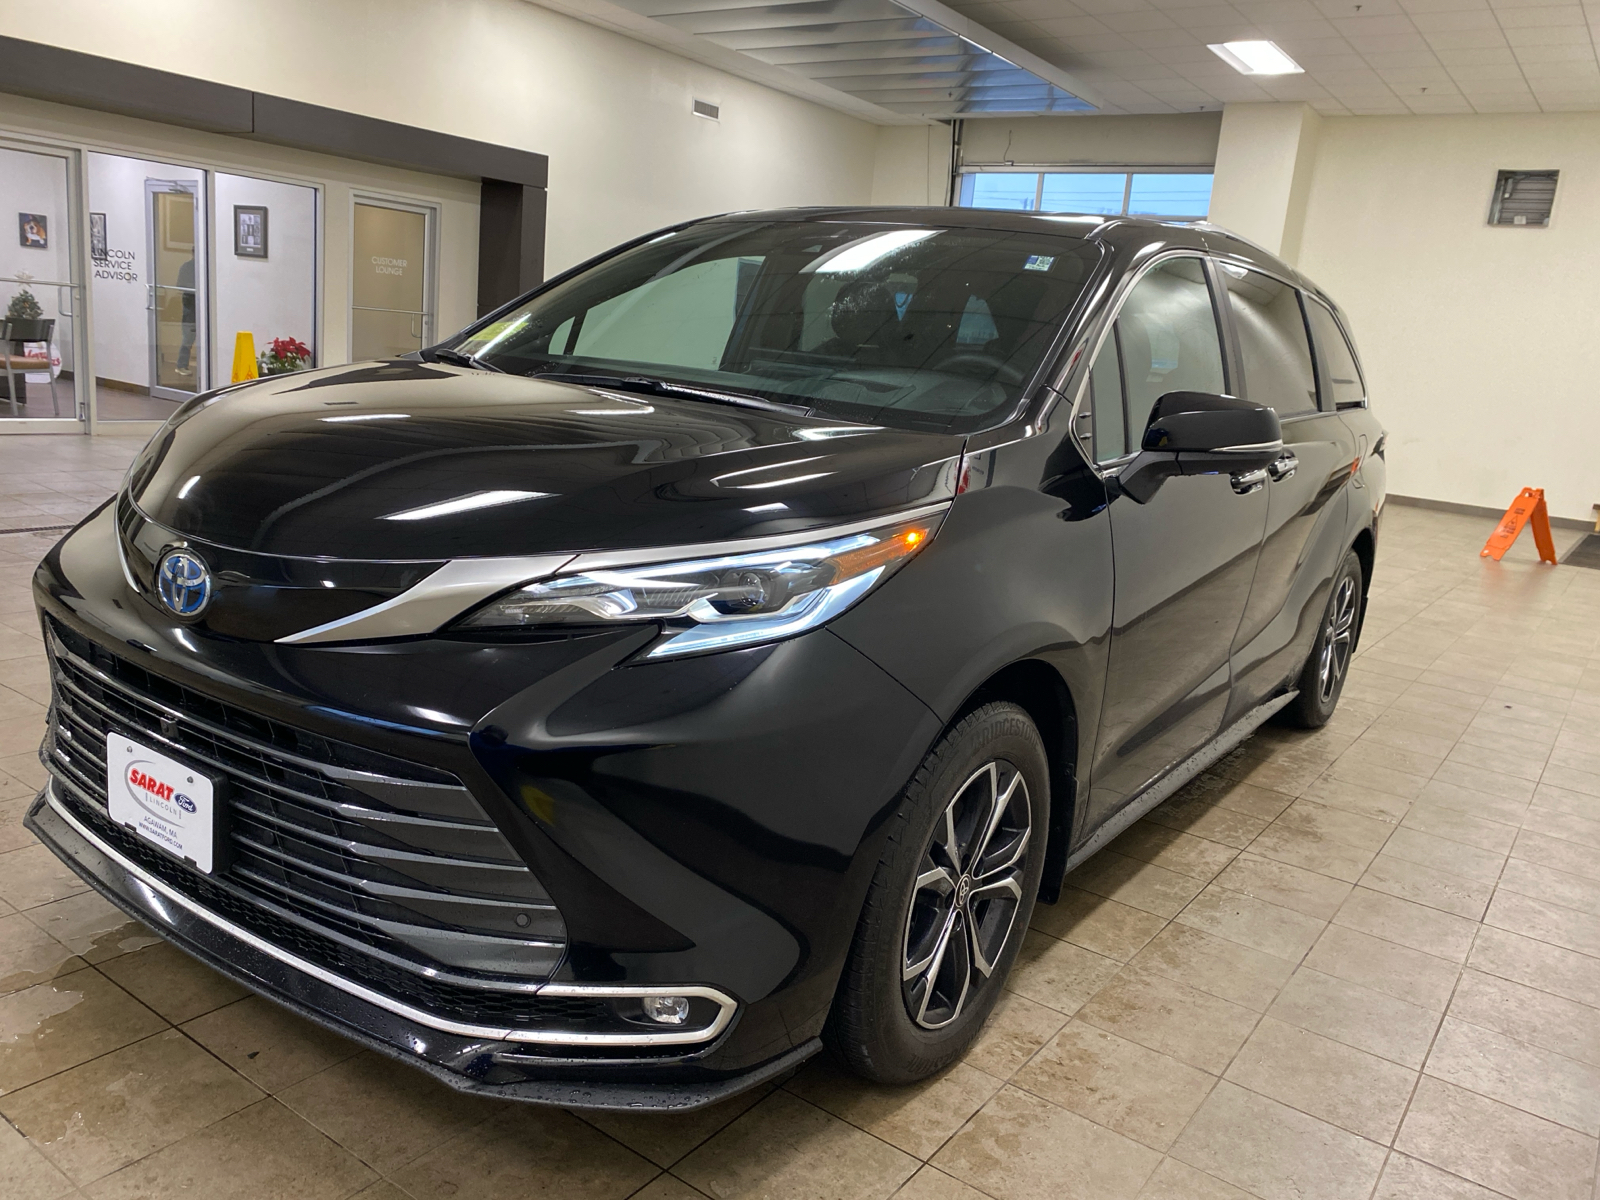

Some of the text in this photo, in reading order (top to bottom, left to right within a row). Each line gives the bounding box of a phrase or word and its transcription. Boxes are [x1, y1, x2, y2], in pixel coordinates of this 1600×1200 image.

[93, 259, 132, 270] SERVICE
[371, 256, 407, 267] CUSTOMER
[94, 270, 138, 281] ADVISOR
[375, 266, 403, 276] LOUNGE
[130, 768, 175, 802] SARAT
[149, 796, 177, 815] LINCOLN
[178, 795, 194, 811] Ford
